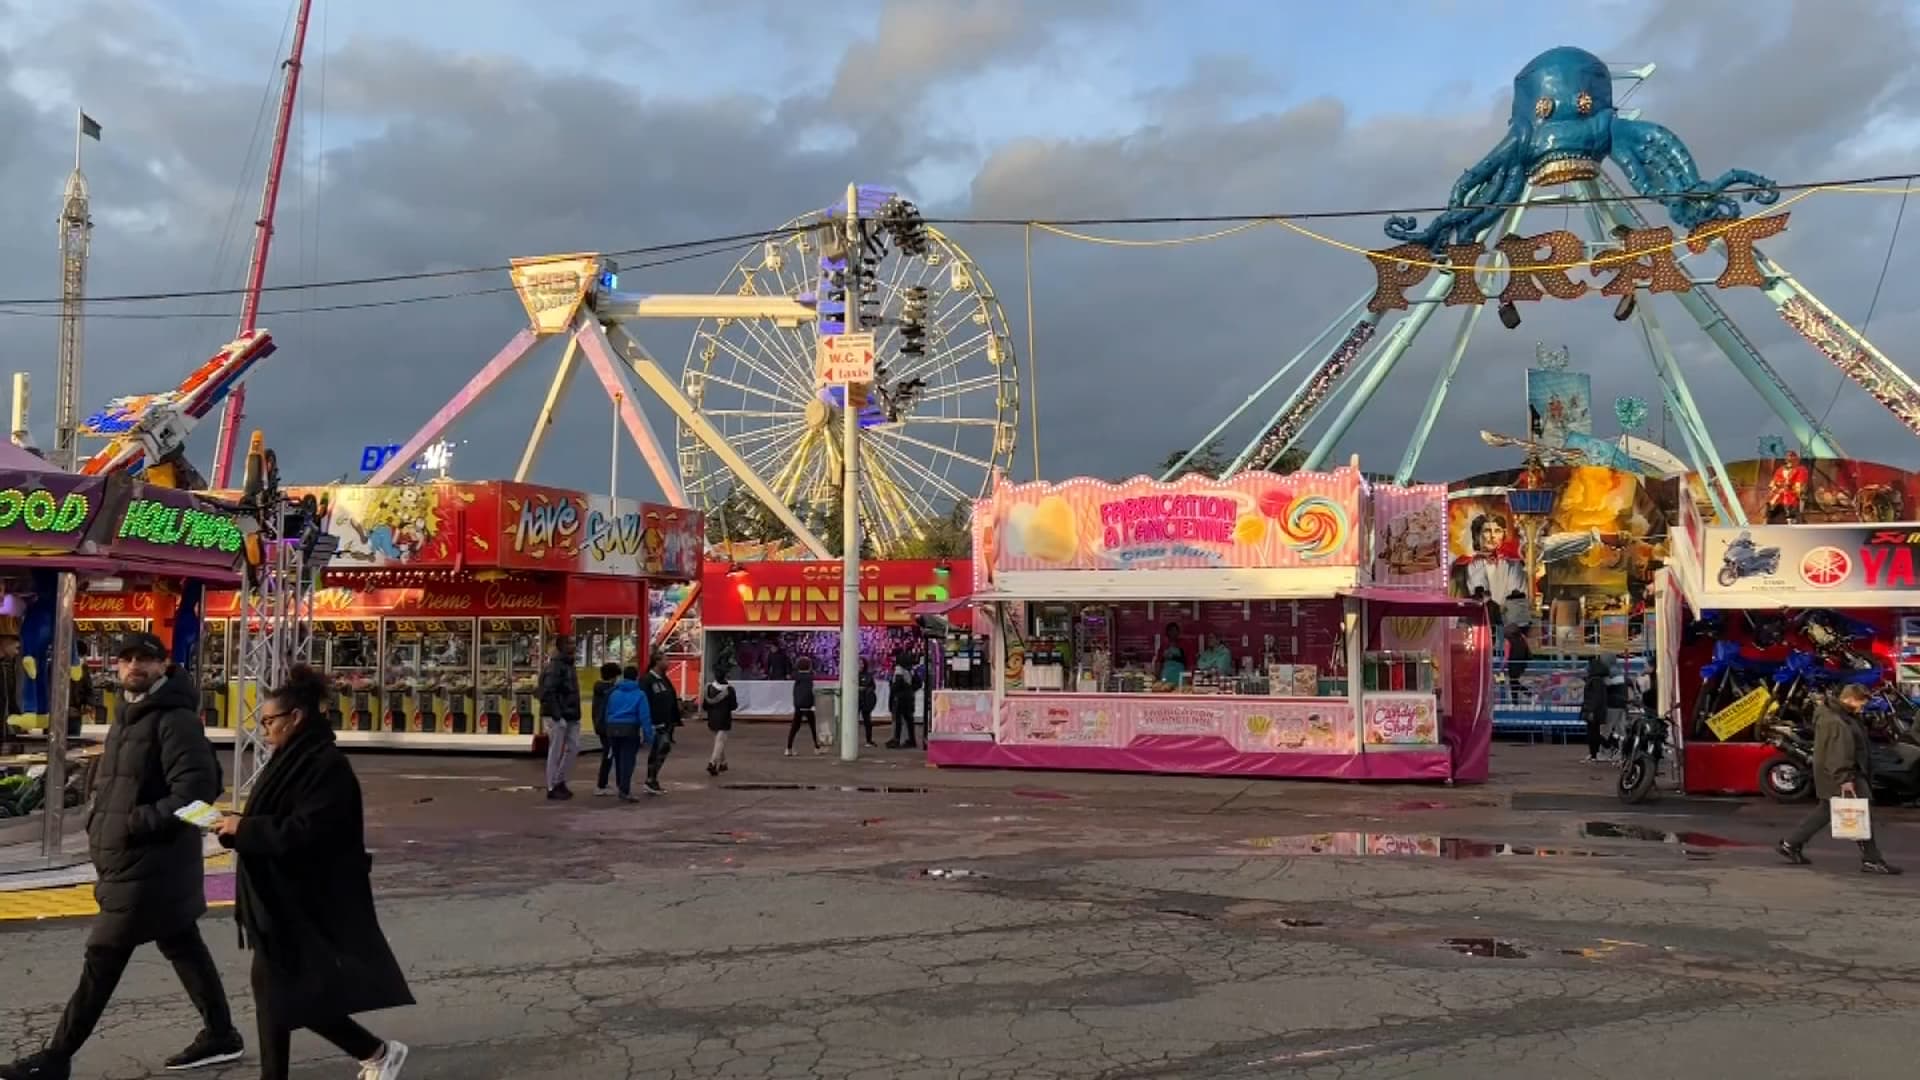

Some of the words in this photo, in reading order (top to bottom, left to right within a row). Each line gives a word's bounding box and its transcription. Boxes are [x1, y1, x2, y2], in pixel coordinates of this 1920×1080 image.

[1367, 211, 1790, 313] PIRAT
[828, 351, 859, 364] W.C.
[514, 497, 580, 552] have
[1101, 495, 1237, 525] FABRICATION
[803, 566, 880, 580] CASO
